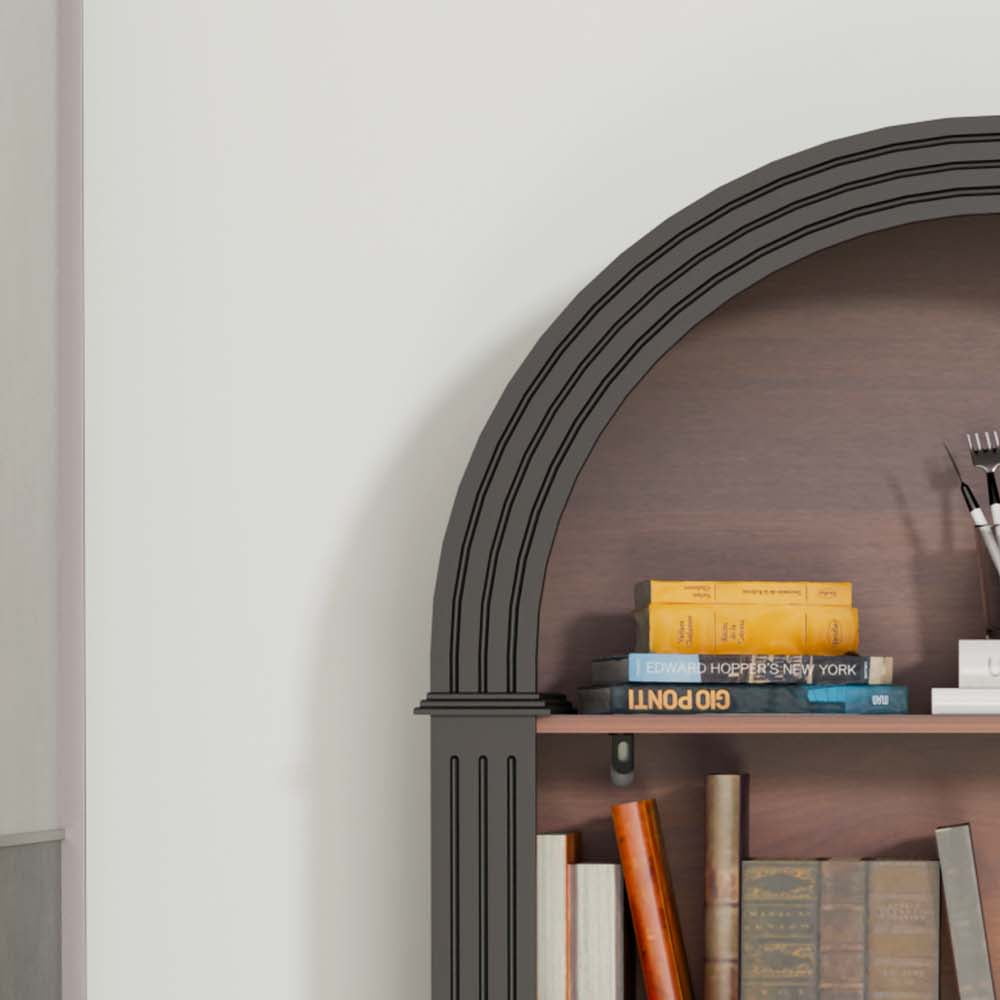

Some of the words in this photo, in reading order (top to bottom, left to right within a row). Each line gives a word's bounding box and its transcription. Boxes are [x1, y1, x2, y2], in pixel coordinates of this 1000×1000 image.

[646, 661, 707, 675] EDWARD
[710, 661, 780, 676] HOPPER'S
[783, 662, 815, 676] NEW
[819, 663, 857, 676] YORK
[627, 688, 693, 711] PONTI
[695, 688, 731, 711] GIO
